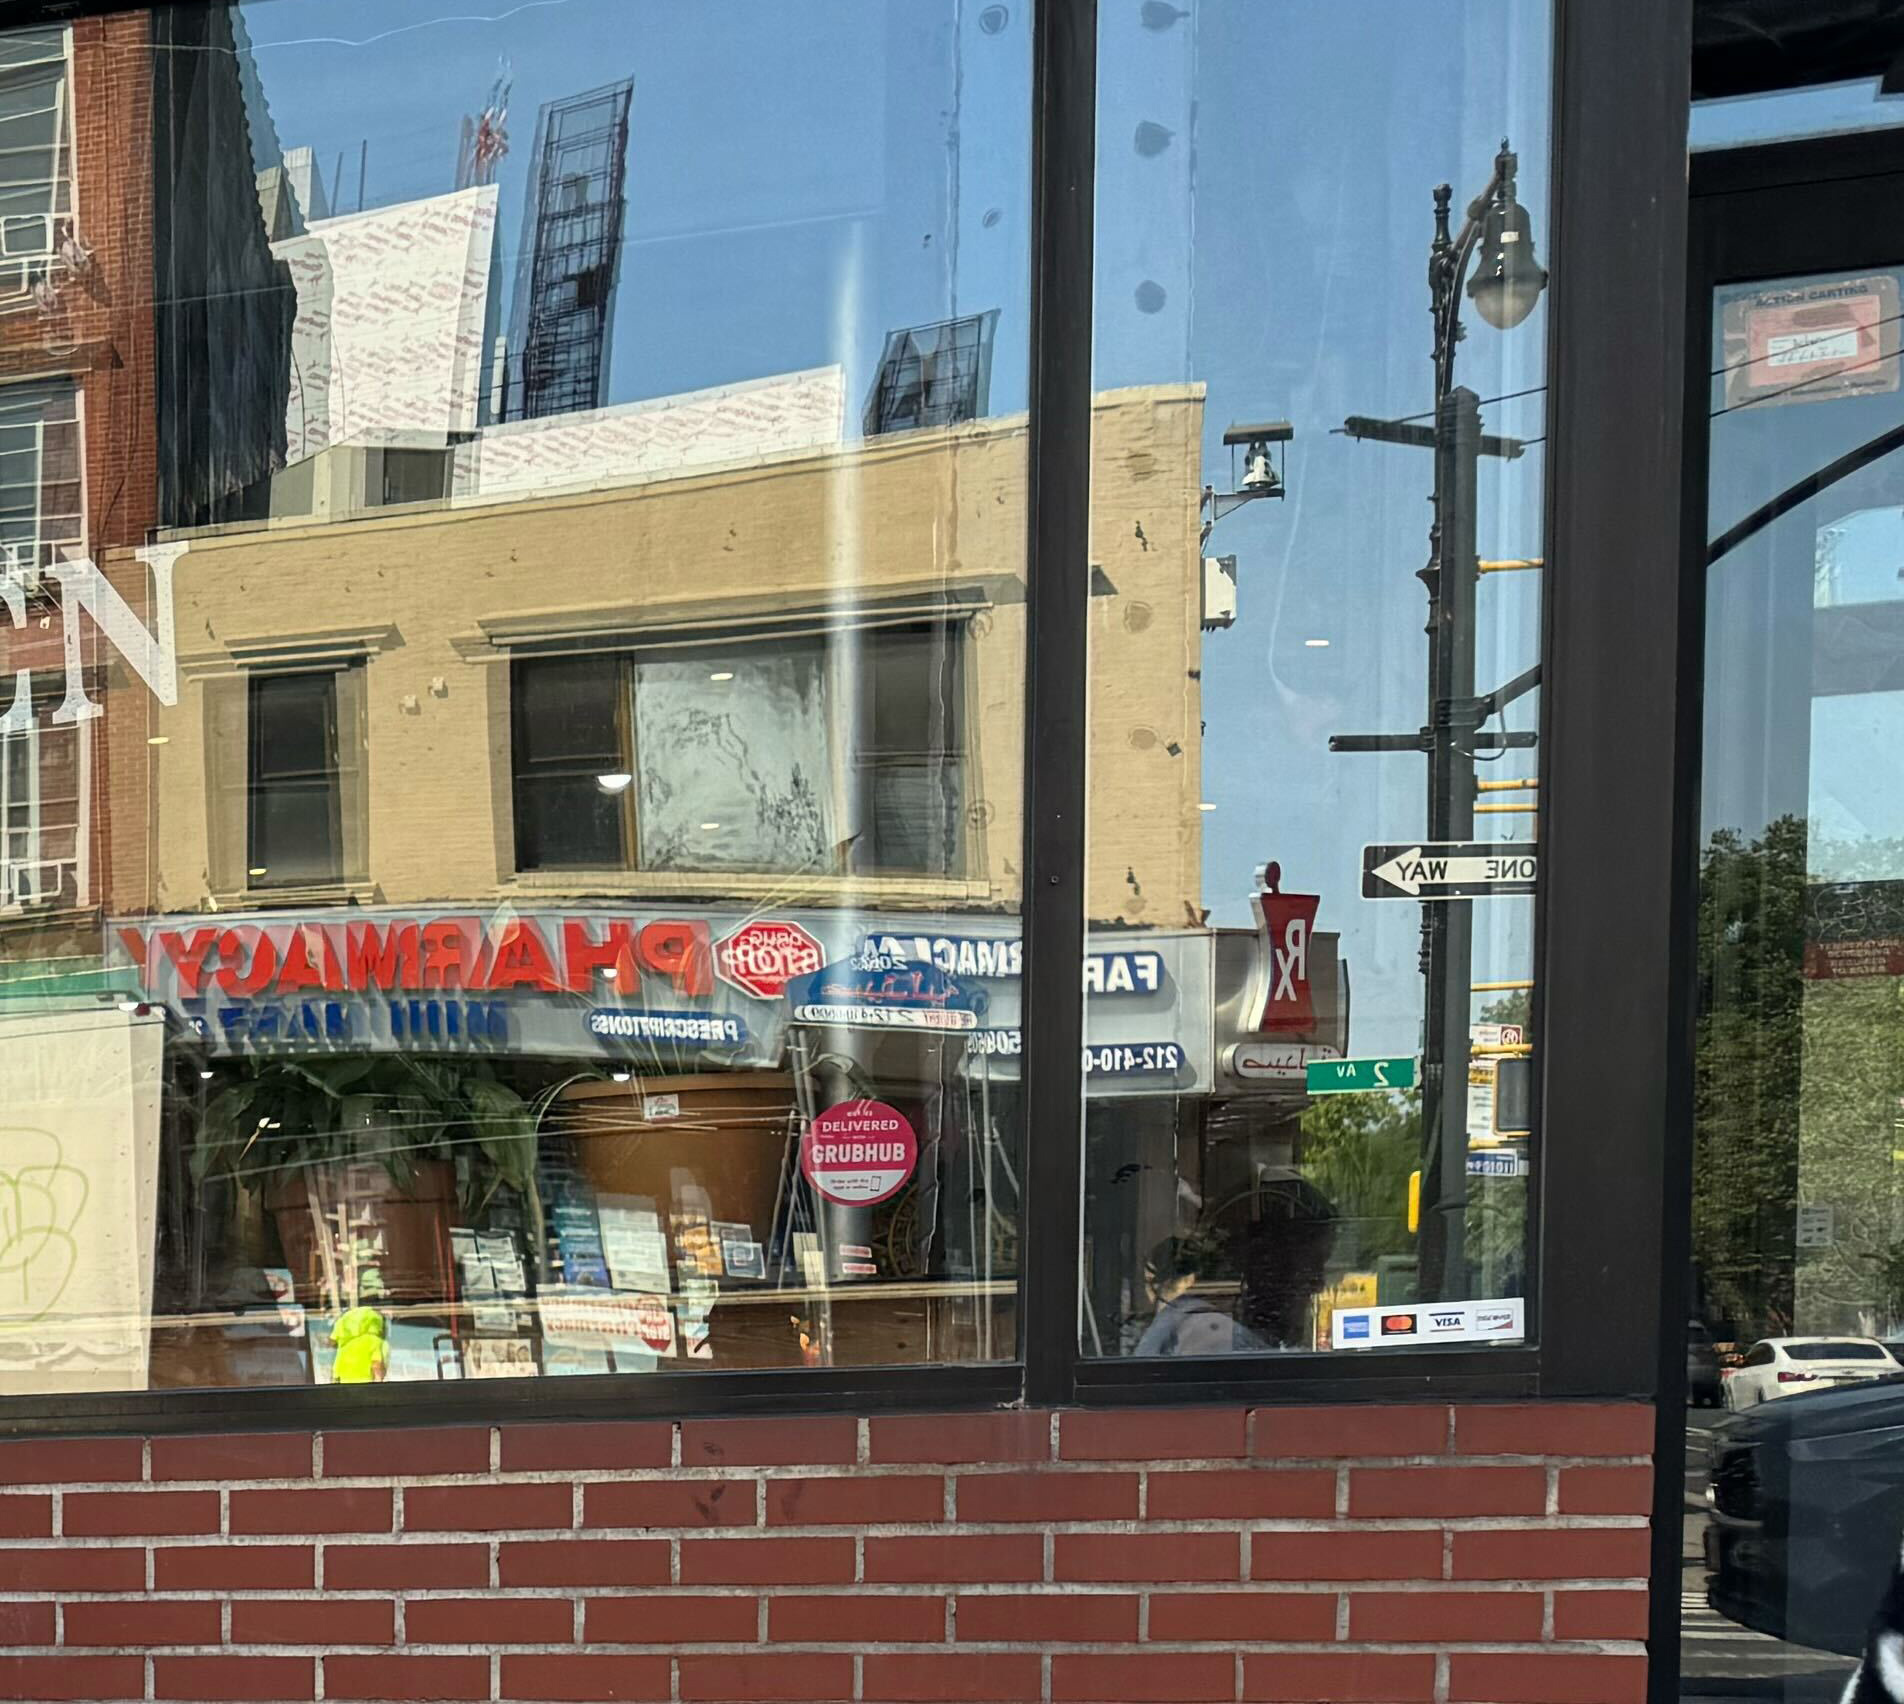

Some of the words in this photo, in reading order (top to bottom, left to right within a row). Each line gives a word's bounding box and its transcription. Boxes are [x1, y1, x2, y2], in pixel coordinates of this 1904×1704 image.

[822, 1119, 899, 1133] DELIVERED
[811, 1142, 906, 1165] GRUBHUB
[1434, 1317, 1462, 1328] VISA
